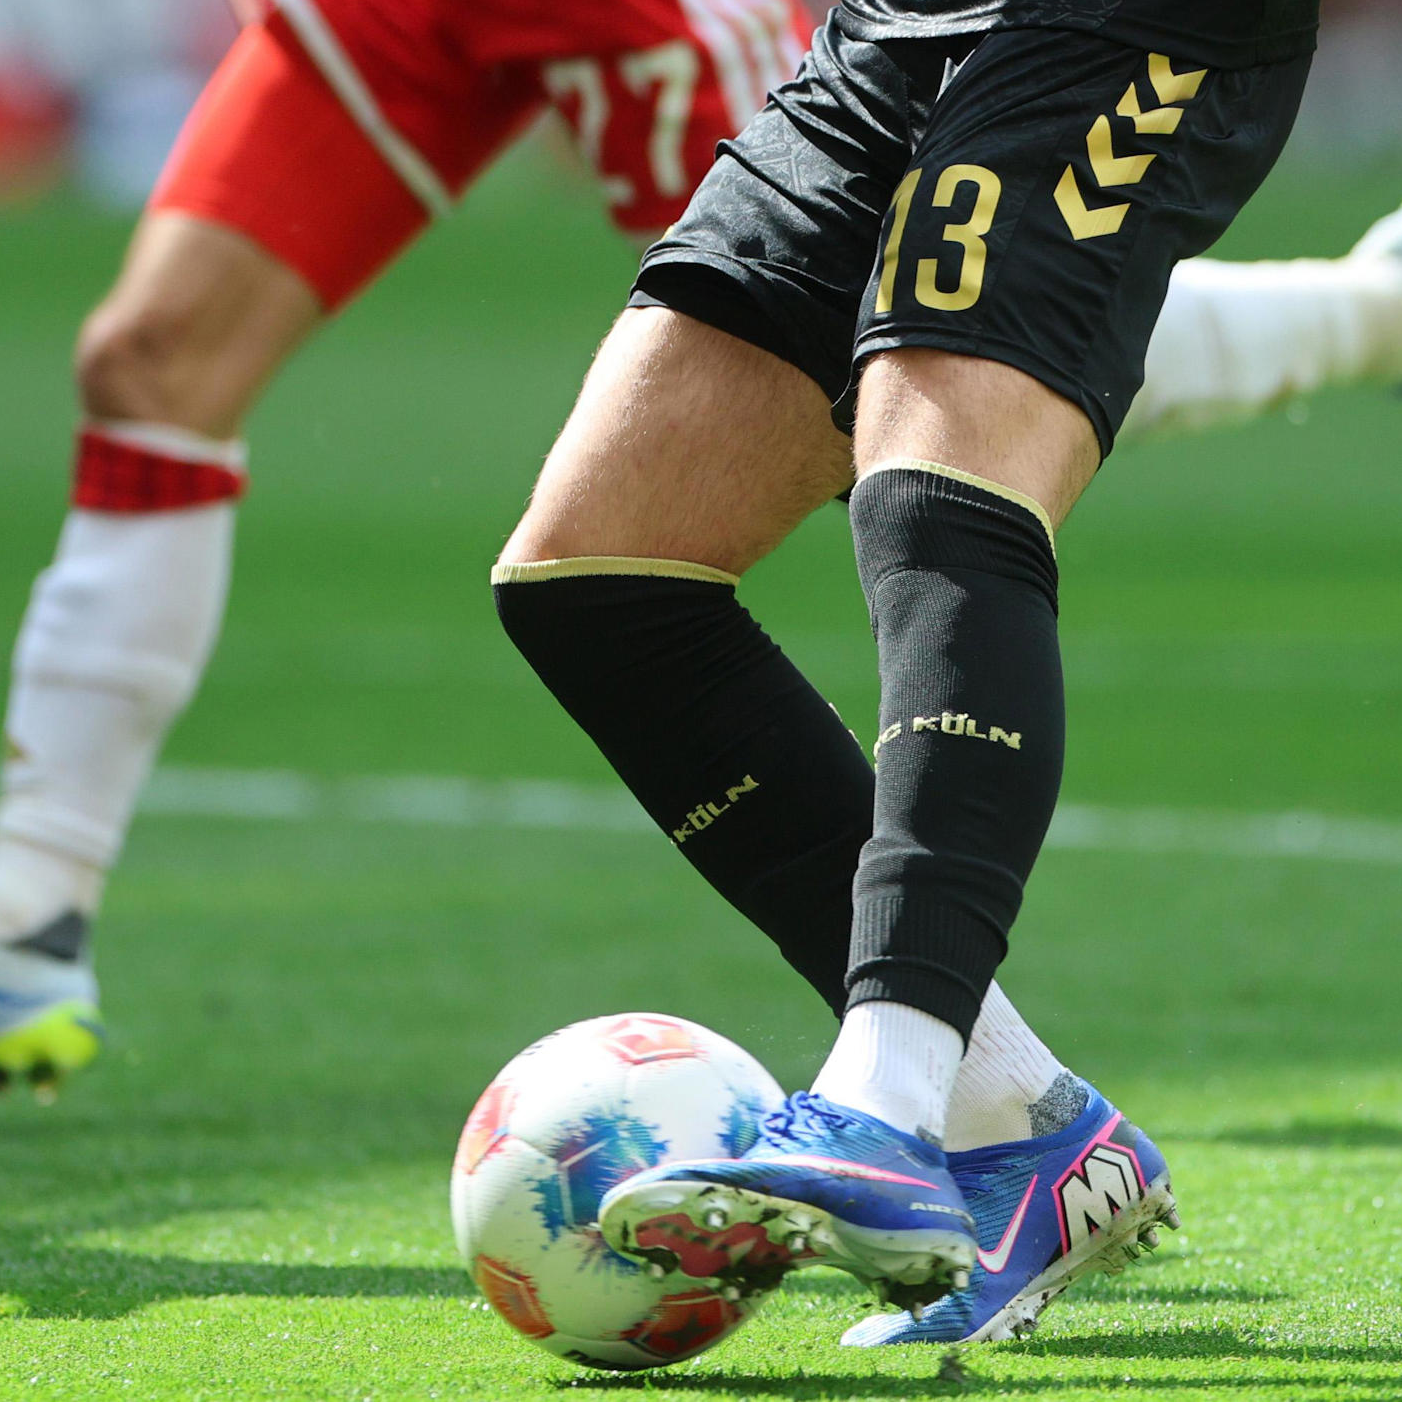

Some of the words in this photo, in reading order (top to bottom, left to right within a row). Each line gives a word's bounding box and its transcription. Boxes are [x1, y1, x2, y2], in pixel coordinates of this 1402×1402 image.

[875, 163, 1002, 312] 13
[912, 711, 1022, 751] KÖLN
[673, 774, 760, 844] KÖLN
